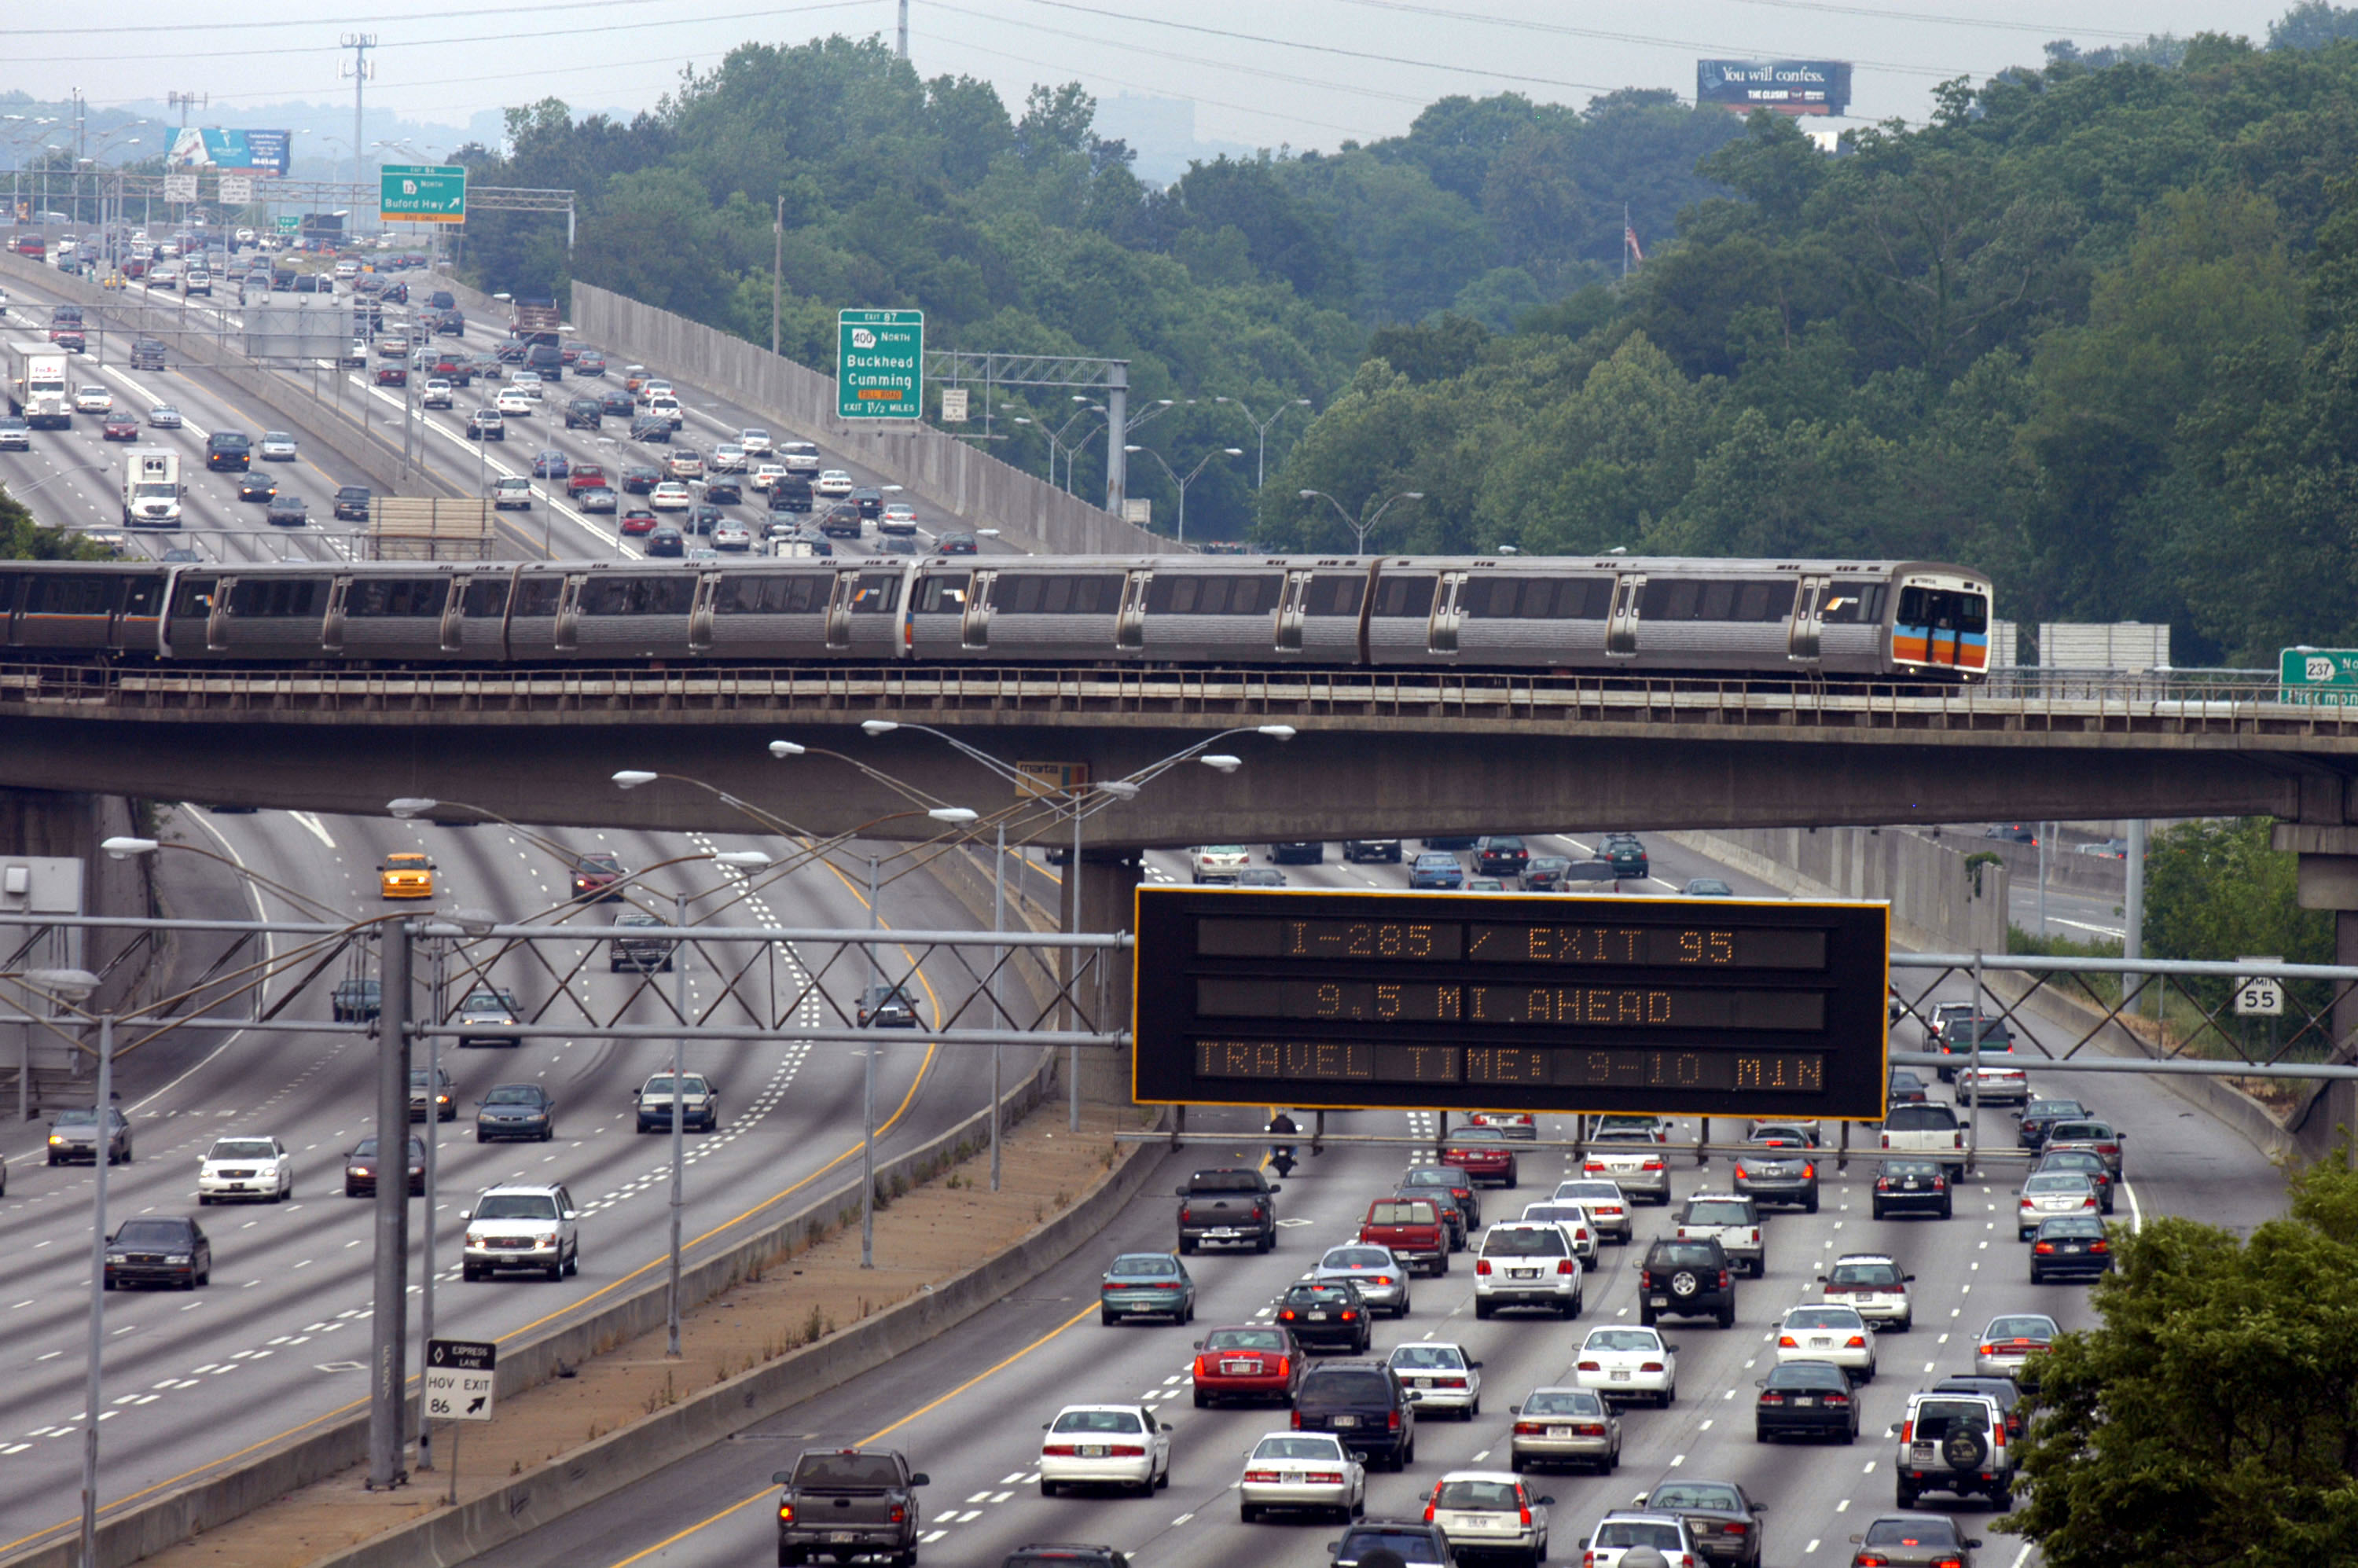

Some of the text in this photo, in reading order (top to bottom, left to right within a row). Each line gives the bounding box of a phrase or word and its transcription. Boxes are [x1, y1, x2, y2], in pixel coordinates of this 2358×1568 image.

[1723, 66, 1825, 82] You will confess.
[1747, 90, 1761, 100] THE
[1762, 90, 1789, 100] CLOSER
[404, 184, 415, 193] 13
[384, 199, 445, 211] Buford Hwy
[883, 313, 898, 322] 87
[854, 332, 910, 343] 400 NORTH
[847, 354, 913, 368] Buckhead
[848, 373, 912, 390] Cumming
[844, 402, 862, 411] EXIT
[890, 403, 915, 412] MILES
[2308, 663, 2330, 676] 237
[1292, 922, 1432, 956] I-285
[1529, 927, 1641, 961] EXIT
[1680, 931, 1733, 963] 95
[1317, 983, 1671, 1023] 9.5 MI AHEAD
[2244, 990, 2275, 1008] 55
[1196, 1040, 1368, 1076] TRAVEL
[1408, 1046, 1541, 1081] TIME:
[1587, 1051, 1700, 1085] 9-10
[452, 1346, 488, 1357] EXPRESS
[459, 1358, 481, 1368] LANE
[428, 1377, 490, 1391] HOV EXIT
[430, 1398, 451, 1414] 86
